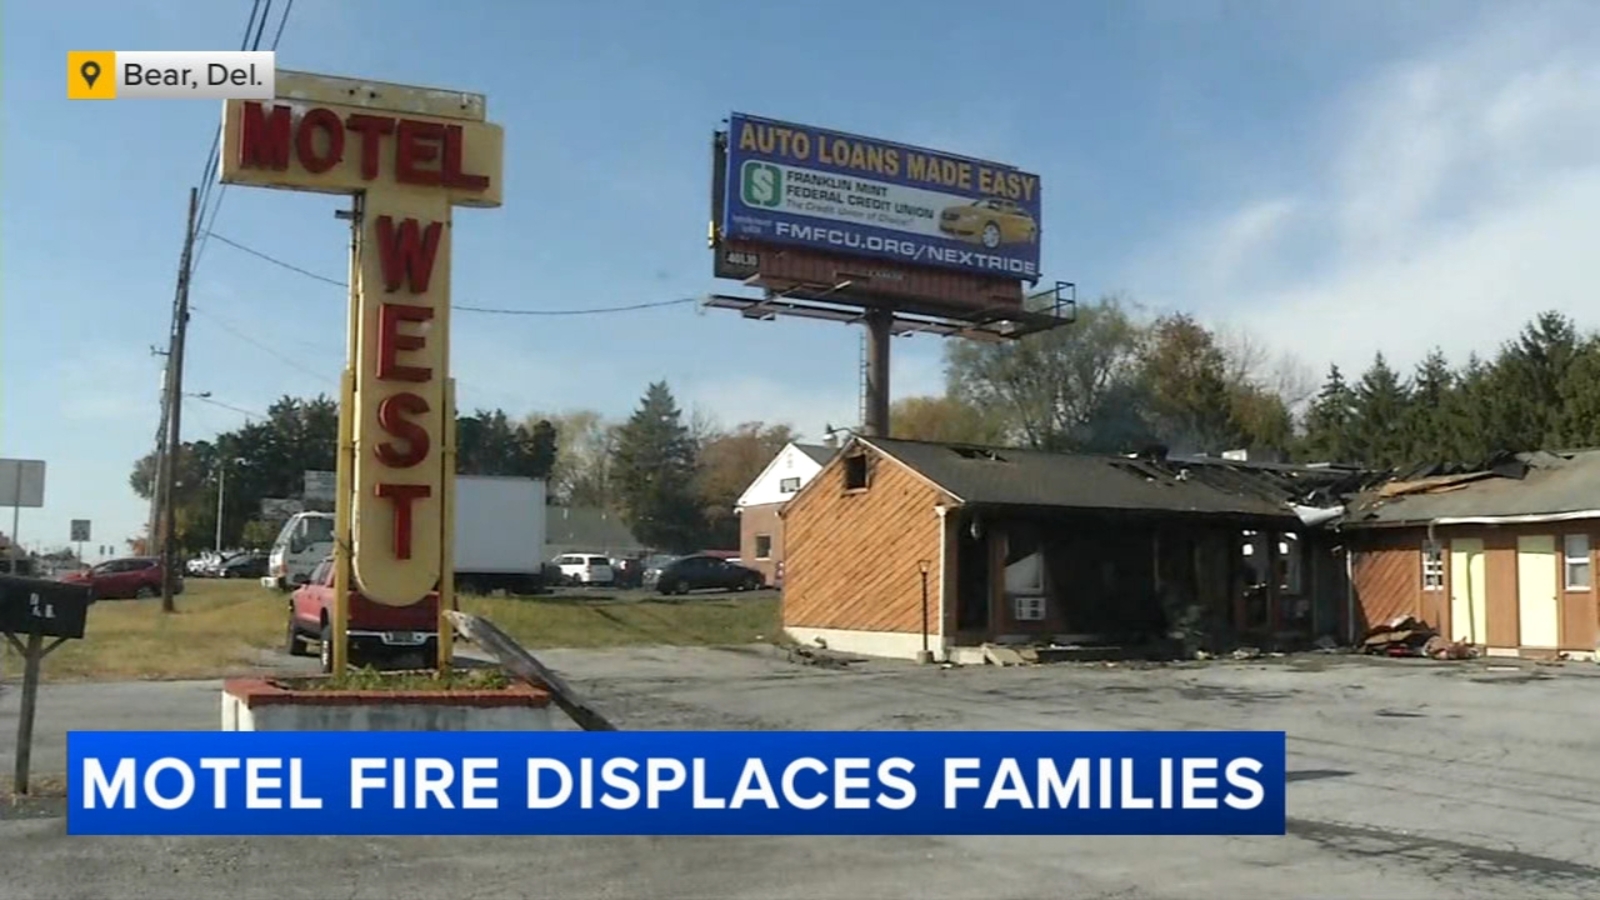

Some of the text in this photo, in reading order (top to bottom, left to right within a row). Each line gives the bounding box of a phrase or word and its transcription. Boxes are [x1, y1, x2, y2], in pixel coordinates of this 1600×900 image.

[240, 101, 490, 191] MOTEL
[740, 122, 1034, 201] AUTO LOANS MADE EASY
[786, 170, 888, 197] FRANKLIN MINT
[786, 185, 934, 219] FEDERAL CREDIT UNION
[775, 221, 1036, 275] FMFCU.ORG/NEXTRIDE
[374, 215, 443, 561] WEST
